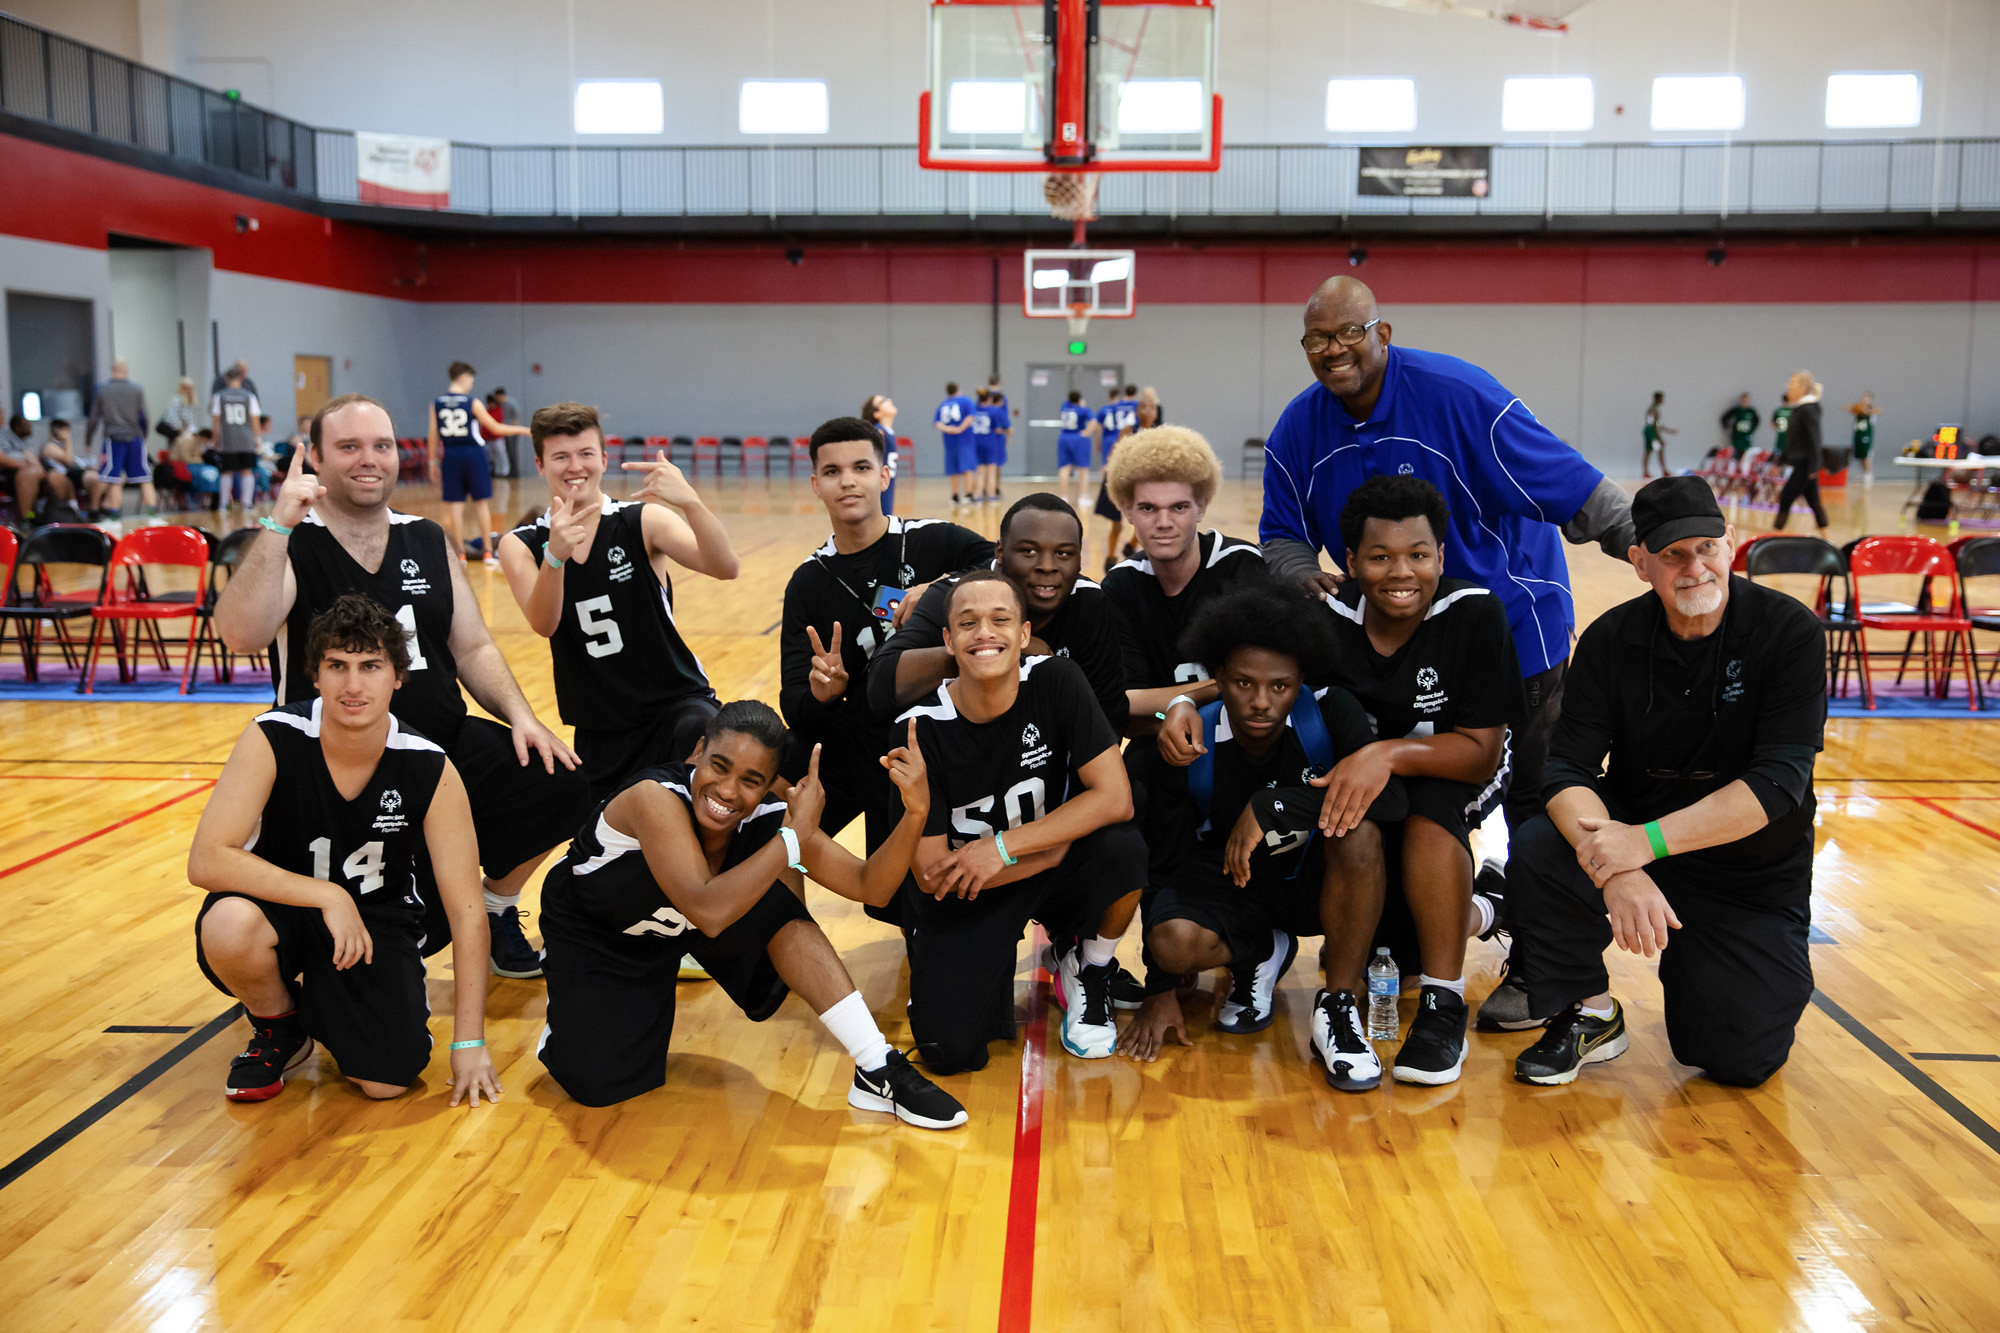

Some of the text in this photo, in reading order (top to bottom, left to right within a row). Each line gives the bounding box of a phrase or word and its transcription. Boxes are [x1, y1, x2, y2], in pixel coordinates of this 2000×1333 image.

[225, 403, 246, 425] 10
[439, 408, 468, 437] 32
[575, 594, 624, 659] 5
[1413, 697, 1448, 708] Olympics
[1416, 690, 1444, 701] Special
[1423, 706, 1441, 714] Florida
[1020, 750, 1052, 767] Olympics
[1021, 743, 1047, 759] Special
[1029, 760, 1047, 770] Florida
[951, 777, 1046, 849] 50
[309, 836, 386, 895] 14
